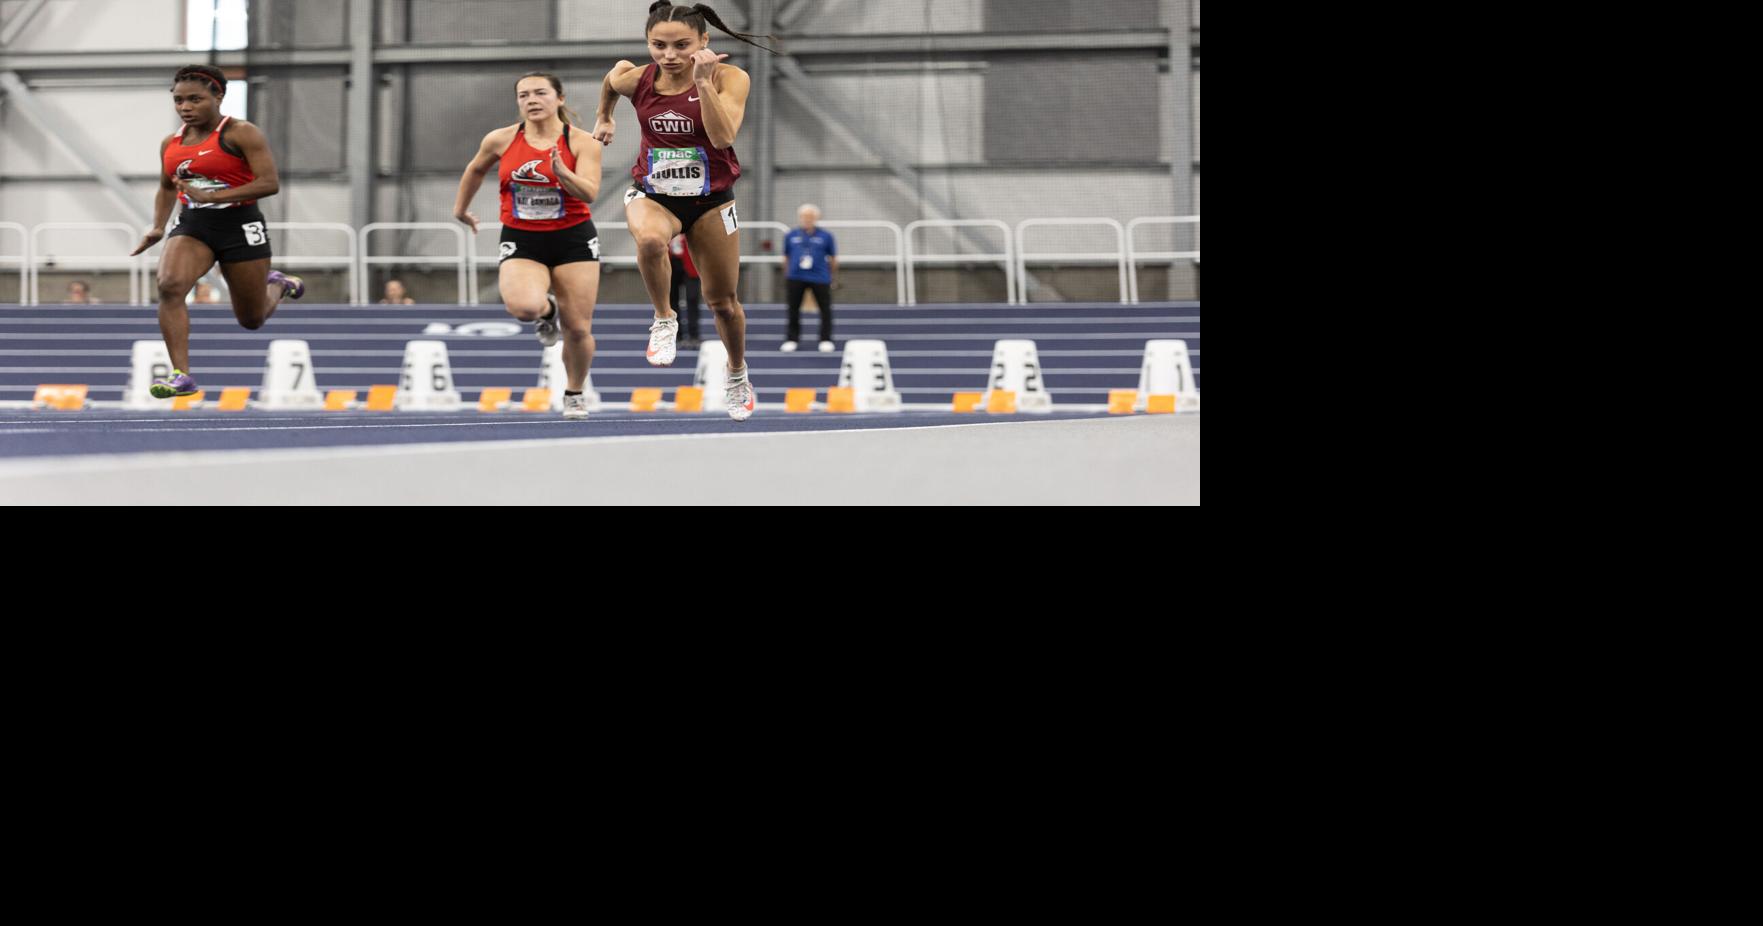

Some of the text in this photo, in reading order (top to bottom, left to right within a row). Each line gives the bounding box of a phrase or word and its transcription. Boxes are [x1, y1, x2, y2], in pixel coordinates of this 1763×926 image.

[652, 120, 692, 133] CWU
[658, 150, 693, 160] gnac
[248, 224, 263, 244] 3
[291, 363, 304, 390] 7
[432, 364, 446, 391] 6
[872, 363, 886, 391] 3
[1024, 363, 1037, 392] 2
